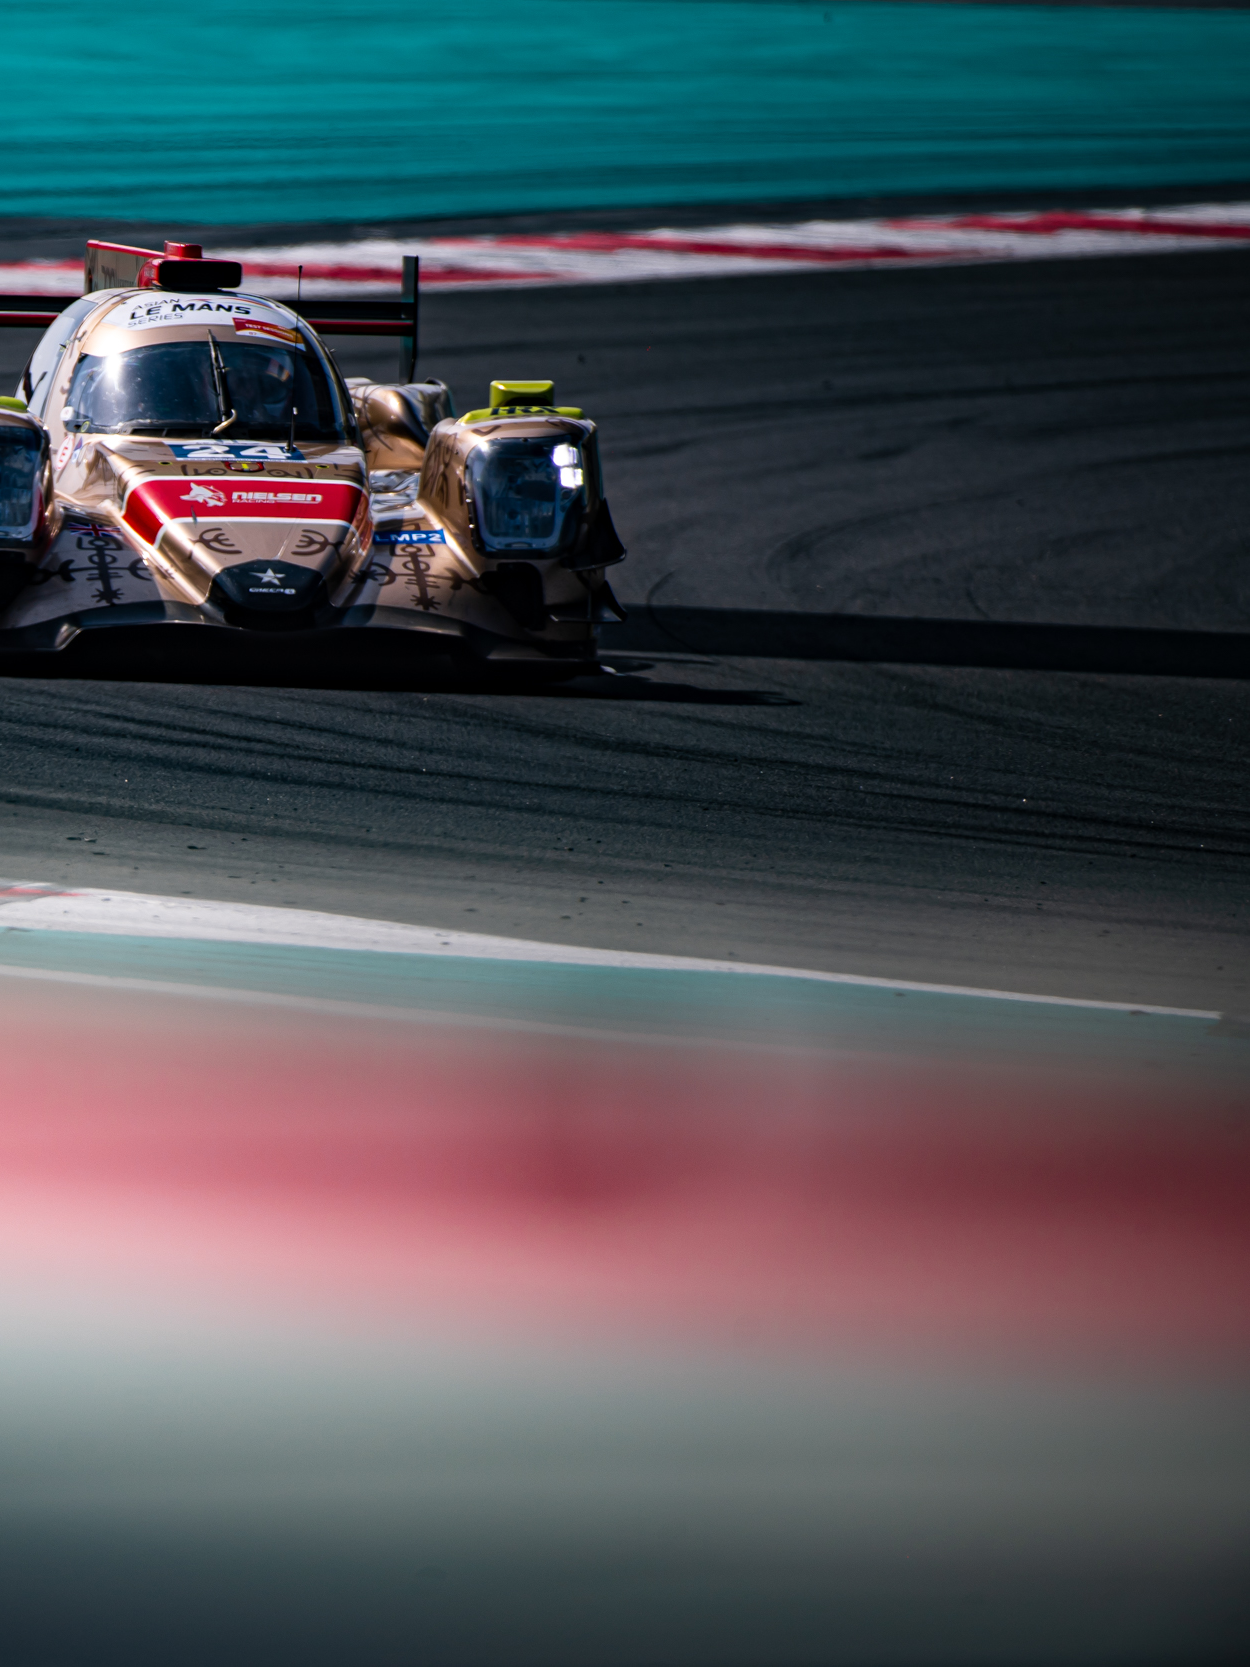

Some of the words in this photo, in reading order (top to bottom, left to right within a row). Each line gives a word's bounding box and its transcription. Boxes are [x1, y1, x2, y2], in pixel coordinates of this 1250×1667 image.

[130, 305, 162, 320] LE
[171, 302, 251, 315] MANS
[132, 298, 180, 311] ASIAN
[127, 312, 183, 328] SERIES
[182, 444, 292, 459] 24
[231, 491, 323, 503] NIELSEN
[374, 533, 442, 542] LMP2
